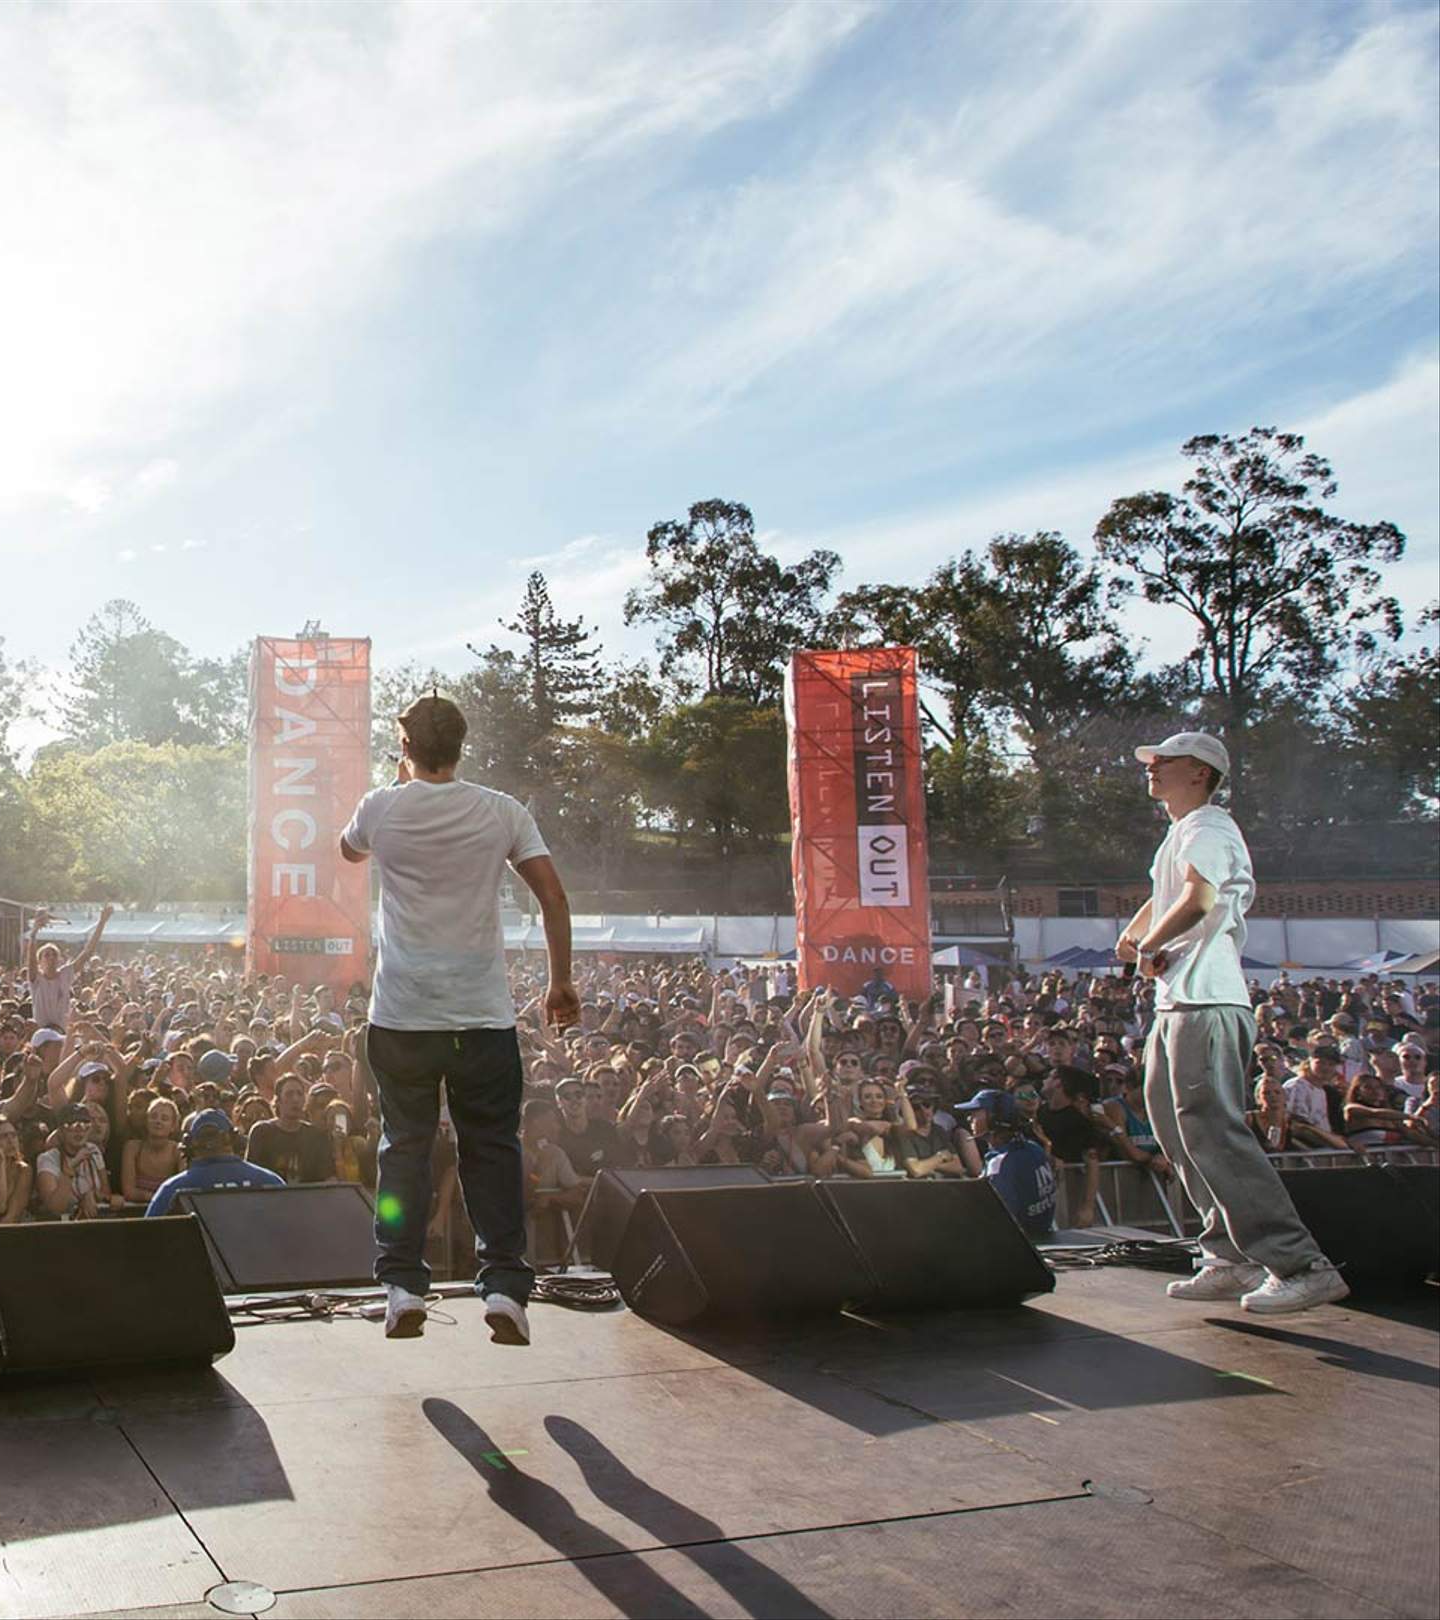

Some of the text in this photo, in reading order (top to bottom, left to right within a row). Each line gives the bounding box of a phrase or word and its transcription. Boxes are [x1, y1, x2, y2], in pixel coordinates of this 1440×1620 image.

[272, 658, 317, 897] DANCE
[862, 681, 899, 897] LISTEN OUT
[327, 941, 350, 951] OUT
[823, 945, 914, 964] DANCE
